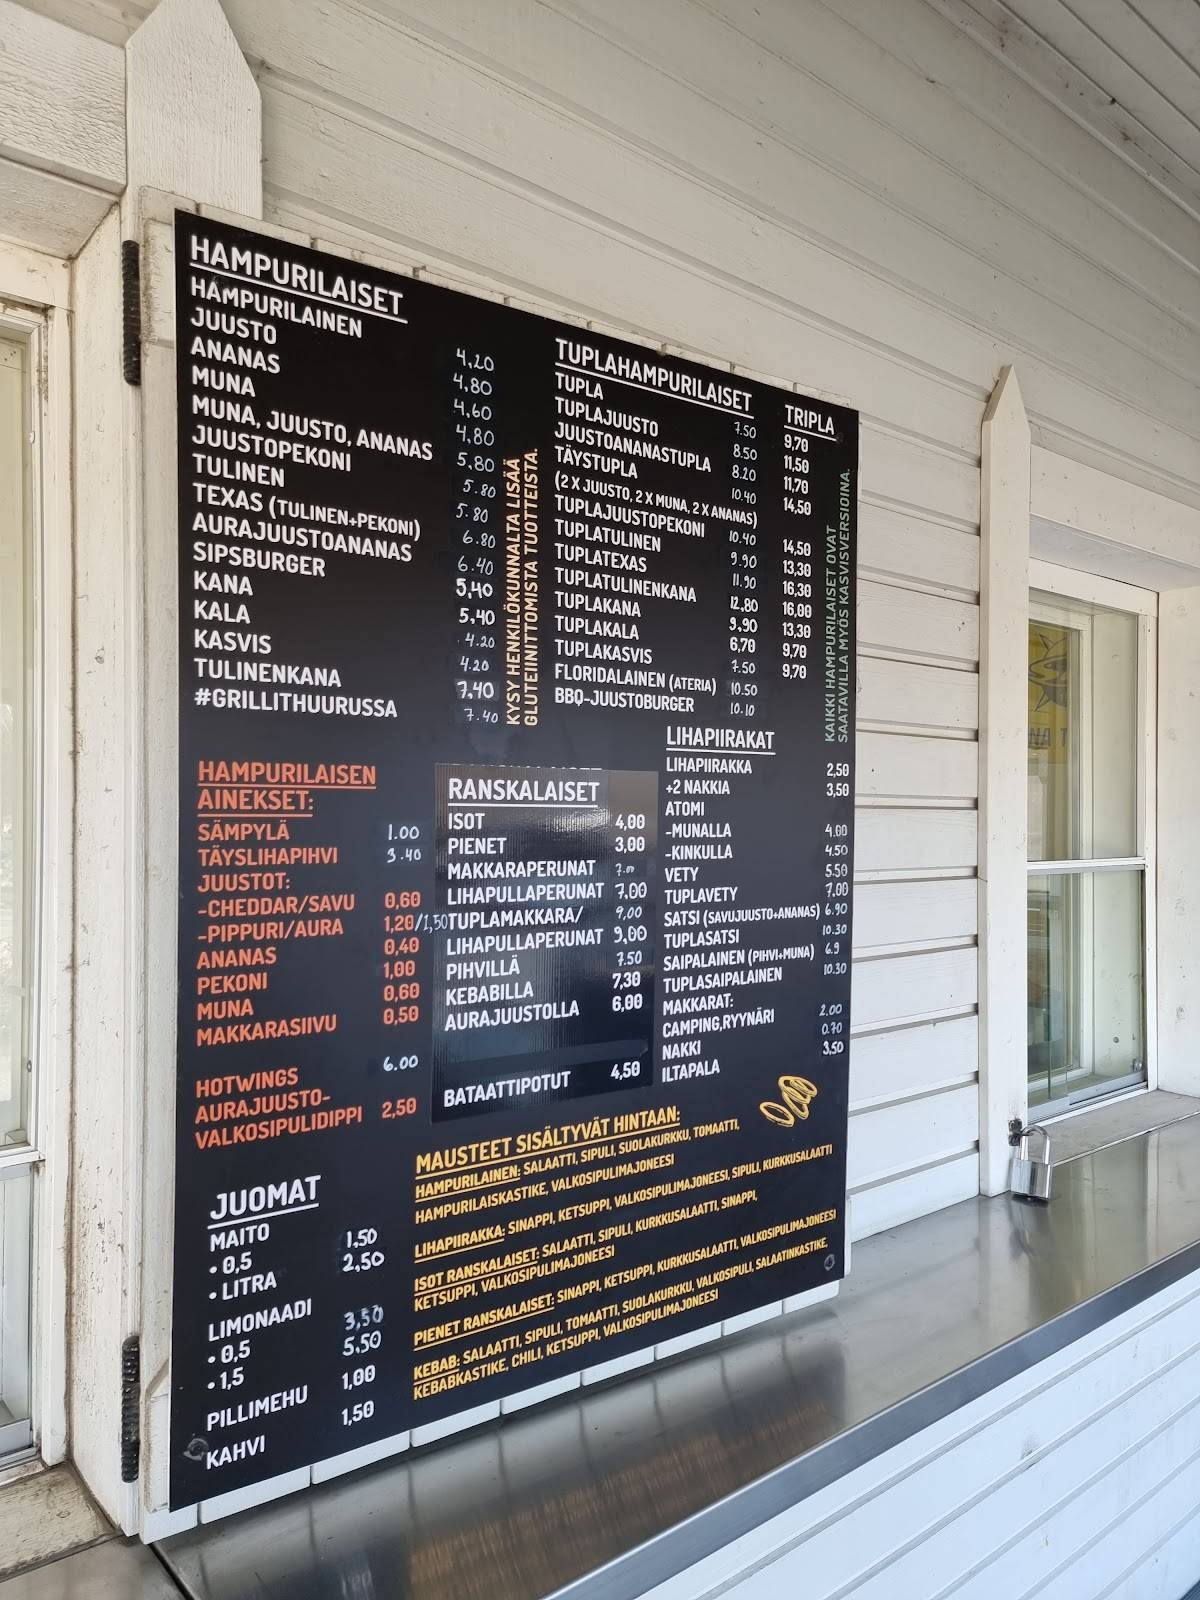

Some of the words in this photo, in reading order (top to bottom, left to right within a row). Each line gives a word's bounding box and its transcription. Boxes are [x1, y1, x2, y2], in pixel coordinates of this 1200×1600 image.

[191, 235, 403, 314] HAMPURILAISET
[191, 276, 362, 338] HAMPURILAINEN
[191, 308, 277, 345] JUUSTO
[191, 337, 280, 374] ANANAS
[456, 348, 495, 371] 4,20
[192, 366, 255, 397] MUNA
[555, 338, 752, 412] TUPLAHAMPURILAISET
[555, 372, 603, 400] TUPLA
[192, 395, 261, 429] MUNA,
[267, 410, 352, 447] JUUSTO,
[357, 429, 433, 460] ANANAS
[555, 397, 658, 437] TUPLAJUUSTO
[785, 404, 834, 435] TRIPLA
[192, 425, 351, 471] JUUSTOPEKONI
[555, 422, 711, 473] JUUSTOANANASTUPLA
[784, 437, 808, 453] 9,70
[192, 453, 285, 487] TULINEN
[555, 446, 638, 479] TÄYSTUPLA
[784, 455, 809, 474] 11,50
[503, 459, 520, 508] LISÄÄ
[784, 477, 808, 495] 11,70
[193, 483, 263, 511] TEXAS
[269, 496, 421, 541] (TULINEN+PEKONI)
[524, 448, 538, 554] TUOTTEISTA.
[784, 497, 811, 516] 14,50
[555, 495, 705, 537] TUPLAJUUSTOPEKONI
[193, 513, 413, 562] AURAJUUSTOANANAS
[555, 519, 661, 552] TUPLATULINEN
[783, 539, 811, 557] 14,50
[826, 525, 836, 564] OVAT
[839, 469, 850, 604] KASVISVERSIOINA.
[193, 542, 325, 577] SIPSBURGER
[555, 543, 647, 573] TUPLATEXAS
[783, 559, 811, 578] 13,30
[194, 571, 253, 596] KANA
[456, 578, 492, 600] 5,40
[503, 514, 520, 675] HENKILÖKUNNALTA
[555, 567, 697, 603] TUPLATULINENKANA
[783, 580, 811, 597] 16,30
[194, 600, 250, 624] KALA
[555, 591, 641, 617] TUPLAKANA
[783, 601, 812, 618] 16,00
[555, 615, 639, 641] TUPLAKALA
[783, 622, 811, 638] 13,30
[826, 568, 836, 688] HAMPURILAISET
[837, 609, 848, 650] MYÖS
[194, 629, 271, 654] KASVIS
[524, 560, 538, 726] GLUTEIINITTOMISTA
[555, 639, 652, 664] TUPLAKASVIS
[729, 638, 755, 653] 6,70
[782, 643, 807, 659] 9,70
[194, 658, 341, 688] TULINENKANA
[555, 663, 665, 688] FLORIDALAINEN
[669, 677, 716, 696] (ATERIA)
[782, 664, 807, 678] 9,70
[195, 688, 398, 718] #GRILLITHUURUSSA
[506, 680, 520, 725] KYSY
[555, 687, 694, 712] BBQ-JUUSTOBURGER
[838, 655, 848, 742] SAATAVILLA
[825, 694, 836, 741] KAIKKI
[666, 726, 774, 749] LIHAPIIRAKAT
[199, 761, 376, 785] HAMPURILAISEN
[666, 757, 752, 774] LIHAPIIRAKKA
[827, 763, 849, 777] 2,50
[198, 789, 313, 810] AINEKSET:
[449, 778, 599, 800] RANSKALAISET
[666, 780, 680, 794] +2
[684, 780, 730, 794] NAKKIA
[827, 783, 849, 797] 3,50
[449, 813, 485, 829] ISOT
[665, 801, 704, 816] ATOMI
[198, 820, 289, 841] SÄMPYLÄ
[615, 814, 645, 830] 4,00
[666, 823, 731, 838] -MUNALLA
[198, 845, 337, 866] TÄYSLIHAPIHVI
[449, 838, 507, 854] PIENET
[615, 837, 645, 854] 3,00
[666, 844, 733, 860] -KINKULLA
[198, 872, 290, 892] JUUSTOT:
[448, 860, 596, 880] MAKKARAPERUNAT
[665, 867, 698, 882] VETY
[198, 894, 355, 918] -CHEDDAR/SAVU
[385, 891, 421, 910] 0,60
[448, 883, 604, 905] LIHAPULLAPERUNAT
[664, 887, 738, 904] TUPLAVETY
[449, 906, 583, 930] TUPLAMAKKARA/
[664, 910, 699, 927] SATSI
[703, 903, 820, 928] (SAVUJUUSTO+ANANAS)
[198, 919, 343, 943] -PIPPURI/AURA
[447, 928, 603, 956] LIHAPULLAPERUNAT
[664, 929, 739, 949] TUPLASATSI
[197, 947, 276, 969] ANANAS
[384, 937, 419, 956] 0,40
[664, 950, 744, 971] SAIPALAINEN
[748, 944, 814, 966] (PIHVI+MUNA)
[447, 955, 520, 980] PIHVILLÄ
[663, 967, 782, 993] TUPLASAIPALAINEN
[198, 972, 267, 995] PEKONI
[384, 983, 420, 1002] 0,60
[613, 971, 641, 990] 7,30
[446, 981, 533, 1006] KEBABILLA
[612, 993, 643, 1012] 6,00
[663, 993, 733, 1016] MAKKARAT:
[197, 999, 254, 1021] MUNA
[445, 1000, 579, 1032] AURAJUUSTOLLA
[197, 1014, 336, 1046] MAKKARASIIVU
[662, 1040, 701, 1060] NAKKI
[196, 1068, 298, 1097] HOTWINGS
[611, 1061, 640, 1080] 4,50
[662, 1059, 720, 1083] ILTAPALA
[444, 1071, 571, 1108] BATAATTIPOTUT
[195, 1089, 330, 1124] AURAJUUSTO-
[382, 1097, 417, 1119] 2,50
[195, 1106, 362, 1149] VALKOSIPULIDIPPI
[416, 1137, 512, 1173] MAUSTEET
[516, 1117, 610, 1153] SISÄLTYVÄT
[614, 1106, 680, 1134] HINTAAN:
[416, 1165, 520, 1199] HAMPURILAINEN:
[524, 1152, 578, 1175] SALAATTI,
[581, 1144, 616, 1164] SIPULI,
[619, 1128, 691, 1155] SUOLAKURKKU,
[694, 1119, 740, 1139] TOMAATTI,
[210, 1175, 321, 1221] JUOMAT
[415, 1224, 505, 1258] LIHAPIIRAKKA:
[508, 1212, 556, 1235] SINAPPI,
[559, 1198, 612, 1222] KETSUPPI,
[615, 1169, 730, 1207] VALKOSIPULIMAJONEESI,
[732, 1162, 761, 1179] SIPULI,
[763, 1144, 832, 1171] KURKKUSALAATTI
[416, 1181, 549, 1225] HAMPURILAISKASTIKE,
[552, 1153, 674, 1192] VALKOSIPULIMAJONEESI
[210, 1223, 270, 1252] MAITO
[415, 1272, 444, 1292] ISOT
[447, 1247, 540, 1284] RANSKALAISET:
[543, 1234, 596, 1258] SALAATTI,
[598, 1222, 633, 1243] SIPULI,
[636, 1199, 719, 1233] KURKKUSALAATTI,
[722, 1190, 757, 1209] SINAPPI,
[222, 1272, 277, 1300] LITRA
[414, 1320, 460, 1346] PIENET
[464, 1293, 554, 1331] RANSKALAISET:
[558, 1279, 602, 1303] SINAPPI,
[604, 1263, 655, 1289] KETSUPPI,
[658, 1238, 739, 1273] KURKKUSALAATTI,
[741, 1209, 837, 1248] VALKOSIPULIMAJONEESI
[209, 1298, 312, 1342] LIMONAADI
[343, 1365, 376, 1390] 1,00
[207, 1385, 308, 1432] PILLIMEHU
[342, 1400, 374, 1426] 1,50
[207, 1435, 265, 1469] KAHVI
